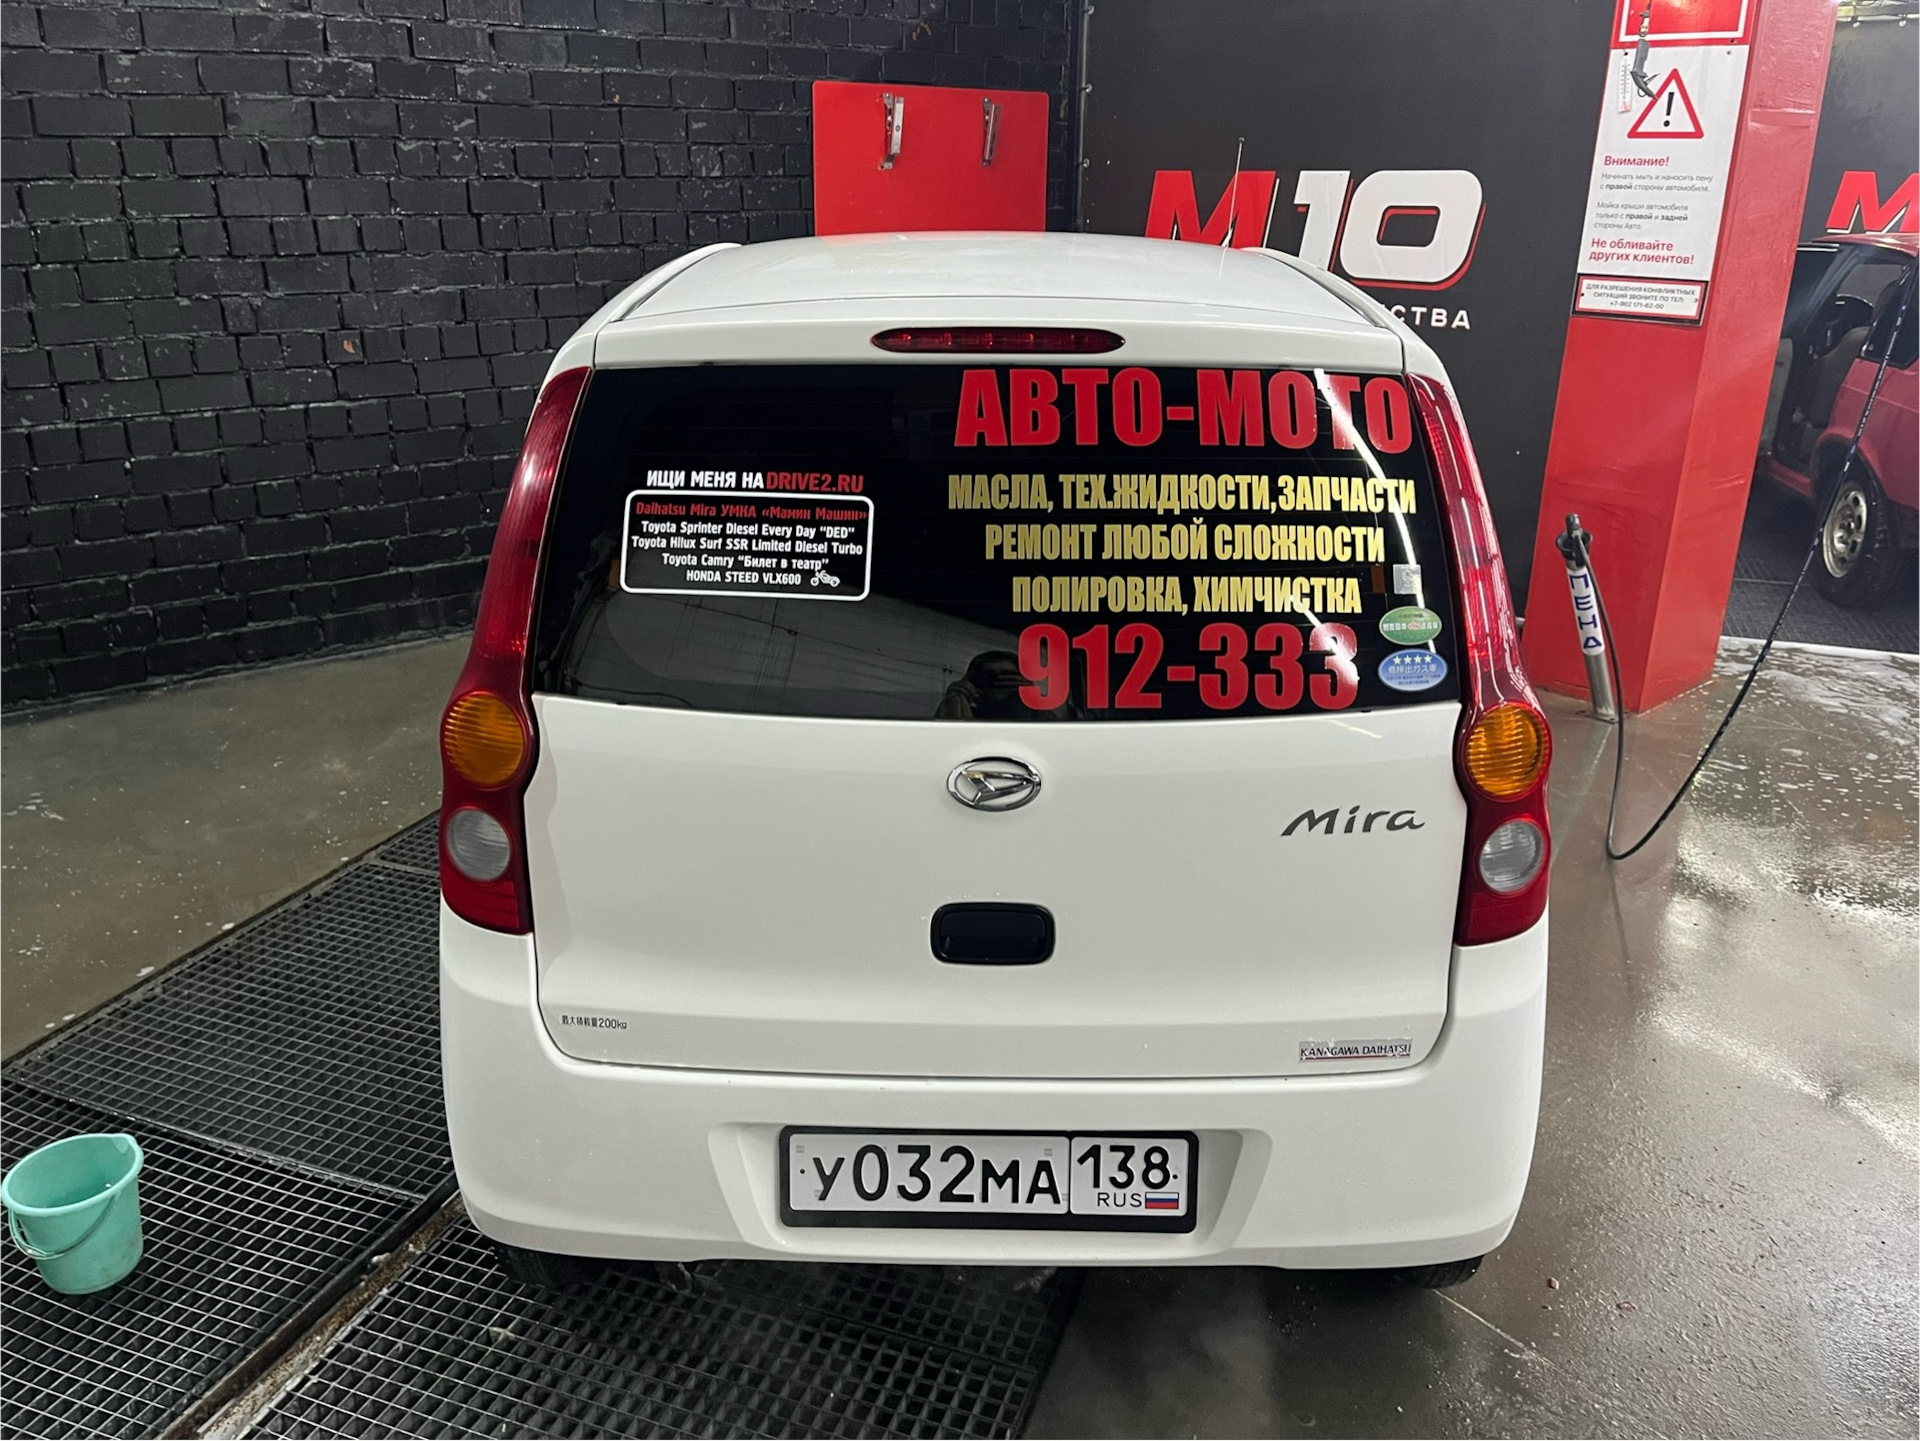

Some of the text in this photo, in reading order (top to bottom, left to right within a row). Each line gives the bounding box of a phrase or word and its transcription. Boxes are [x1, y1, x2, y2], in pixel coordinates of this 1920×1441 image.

[1603, 155, 1670, 167] Внимание!
[1601, 172, 1634, 180] Начинать
[1695, 175, 1713, 183] пену
[1605, 183, 1632, 191] правой
[1665, 184, 1710, 192] автомобиля.
[1645, 203, 1688, 211] автомобиля
[1593, 222, 1623, 230] стороны
[1625, 213, 1653, 221] правой
[1660, 214, 1688, 222] задней
[1591, 238, 1674, 252] Не обливайте
[1589, 251, 1695, 265] других клиентов!
[1593, 291, 1627, 299] СИТУАЦИЙ
[1600, 284, 1642, 292] РАЗРЕШЕНИЯ
[1643, 286, 1695, 295] КОНФЛИКТНЫХ
[1382, 304, 1471, 330] СТВА
[953, 367, 1413, 454] АВТО-МОТО
[646, 470, 864, 493] ИЩИ МЕНЯ НА DRIVE2.RU
[948, 474, 1054, 513] МАСЛА,
[636, 501, 867, 520] Daihatsu Mira УМНА «Мамин Машин»
[641, 520, 677, 535] Toyota
[680, 521, 723, 535] Sprinter
[726, 522, 758, 535] Diesel
[762, 523, 792, 538] Every
[796, 525, 816, 539] Day
[631, 535, 863, 555] Toyota Hilux Surf SSR Limited Diesel Turbo
[985, 516, 1385, 563] РЕМОНТ ЛЮБОЙ СЛОЖНОСТИ
[662, 552, 698, 567] Toyota
[701, 554, 734, 569] Camry
[780, 558, 788, 569] в
[686, 569, 802, 585] HONDA STEED VLX600
[1012, 576, 1363, 617] ПОЛИРОВКА, ХИМЧИСТКА
[1018, 622, 1359, 712] 912-333
[1281, 805, 1425, 837] Mira
[1300, 1046, 1359, 1057] KANAGAWA
[1077, 1144, 1172, 1190] 138
[1097, 1191, 1143, 1208] RUS
